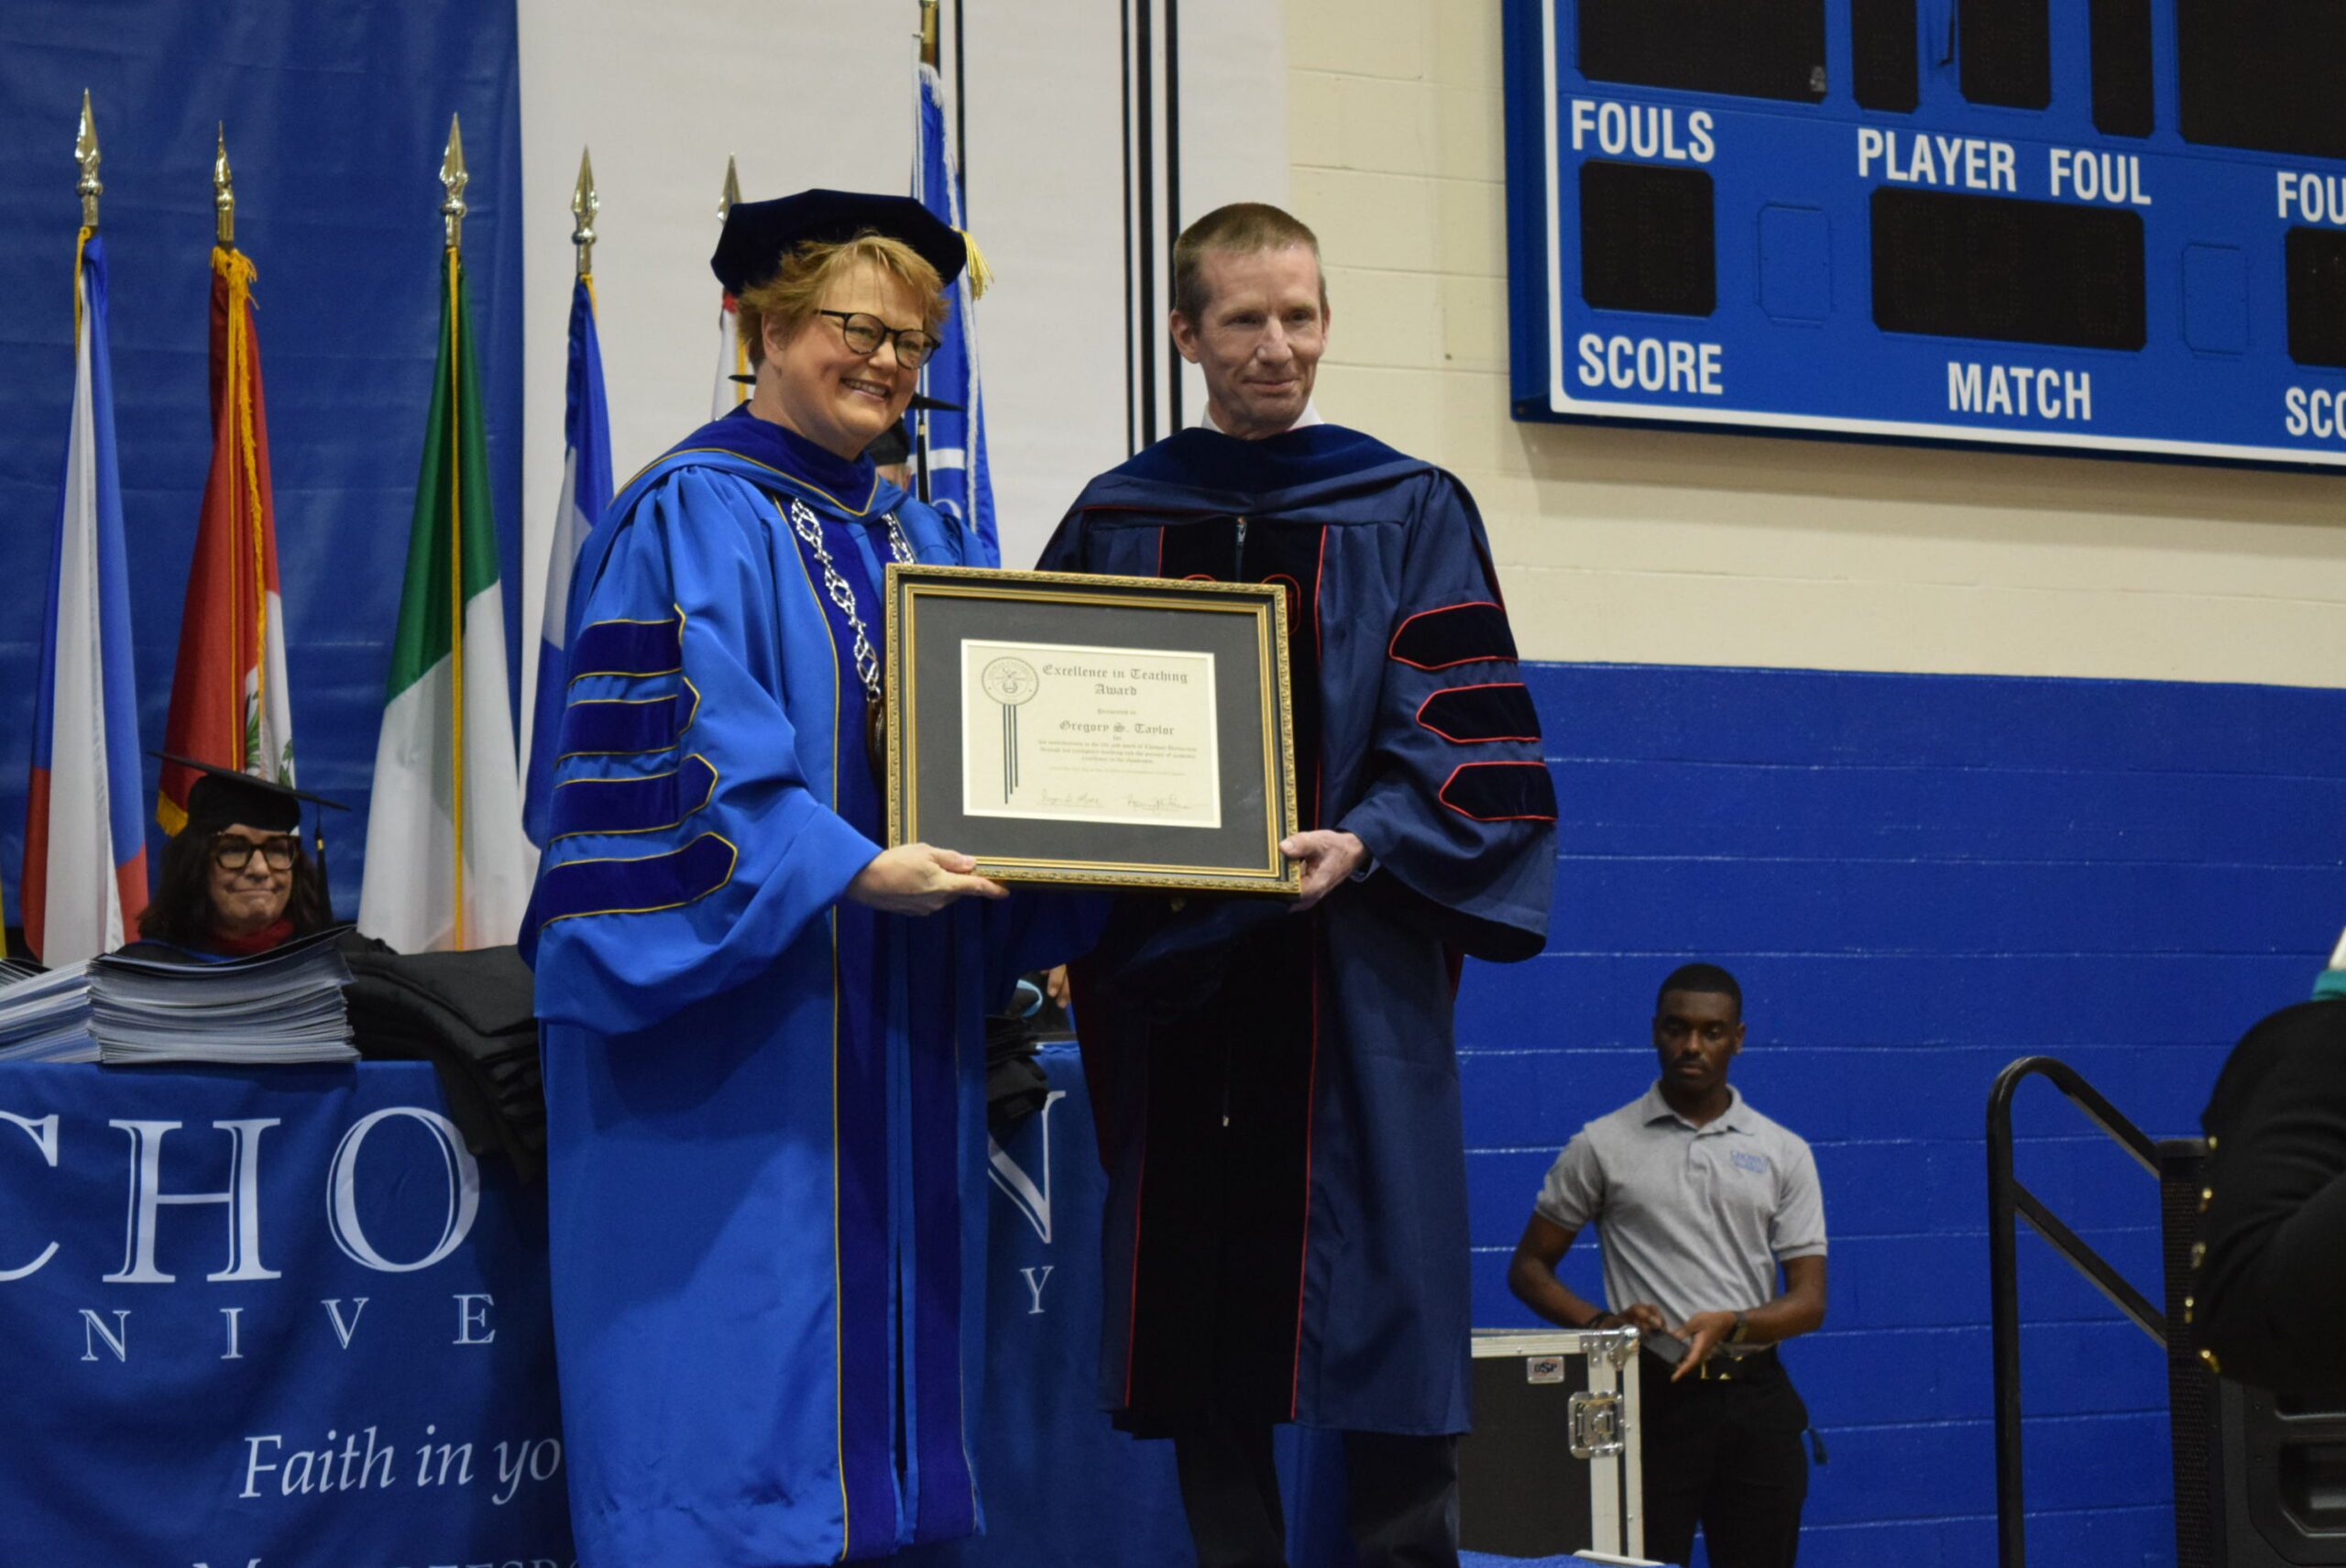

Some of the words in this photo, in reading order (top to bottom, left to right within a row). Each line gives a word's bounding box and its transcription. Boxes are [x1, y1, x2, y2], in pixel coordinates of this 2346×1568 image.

[1571, 100, 1716, 163] FOULS
[1858, 127, 2017, 192] PLAYER
[2049, 147, 2153, 206] FOUL
[1578, 333, 1723, 396] SCORE
[1947, 361, 2091, 421] MATCH
[1042, 663, 1108, 679] Excellence
[1113, 666, 1125, 679] in
[1130, 668, 1189, 685] Teaching
[1095, 684, 1137, 696] Award
[1059, 719, 1110, 734] Gregory
[1135, 722, 1176, 736] Taylor
[239, 1425, 396, 1498] Faith
[416, 1423, 475, 1488] in
